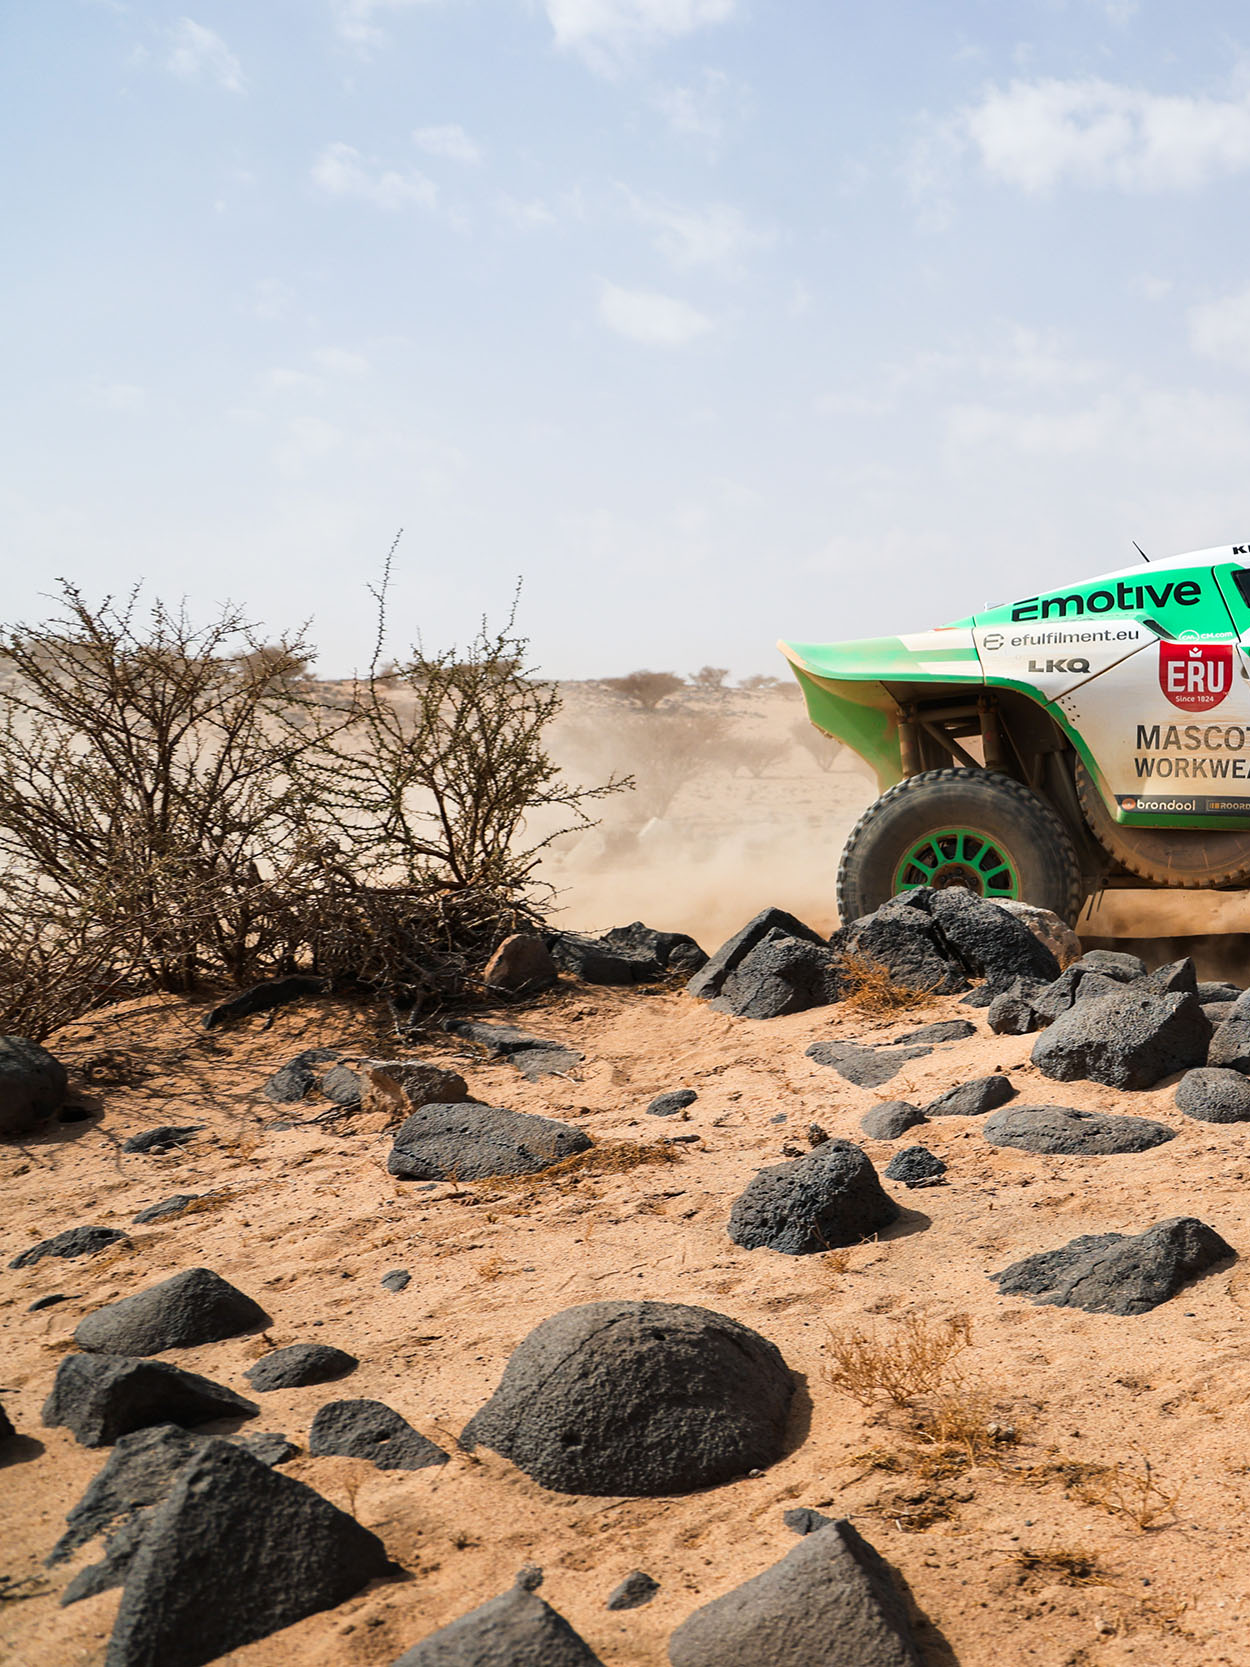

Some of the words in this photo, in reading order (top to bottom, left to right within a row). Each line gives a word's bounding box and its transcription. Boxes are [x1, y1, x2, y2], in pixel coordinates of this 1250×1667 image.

[1011, 580, 1202, 622] Emotive
[1011, 629, 1140, 647] efulfilment.eu
[1201, 631, 1233, 639] CM.com
[1028, 658, 1091, 674] LKQ
[1167, 661, 1224, 693] ERU
[1175, 695, 1195, 703] Since
[1136, 799, 1196, 811] brondool
